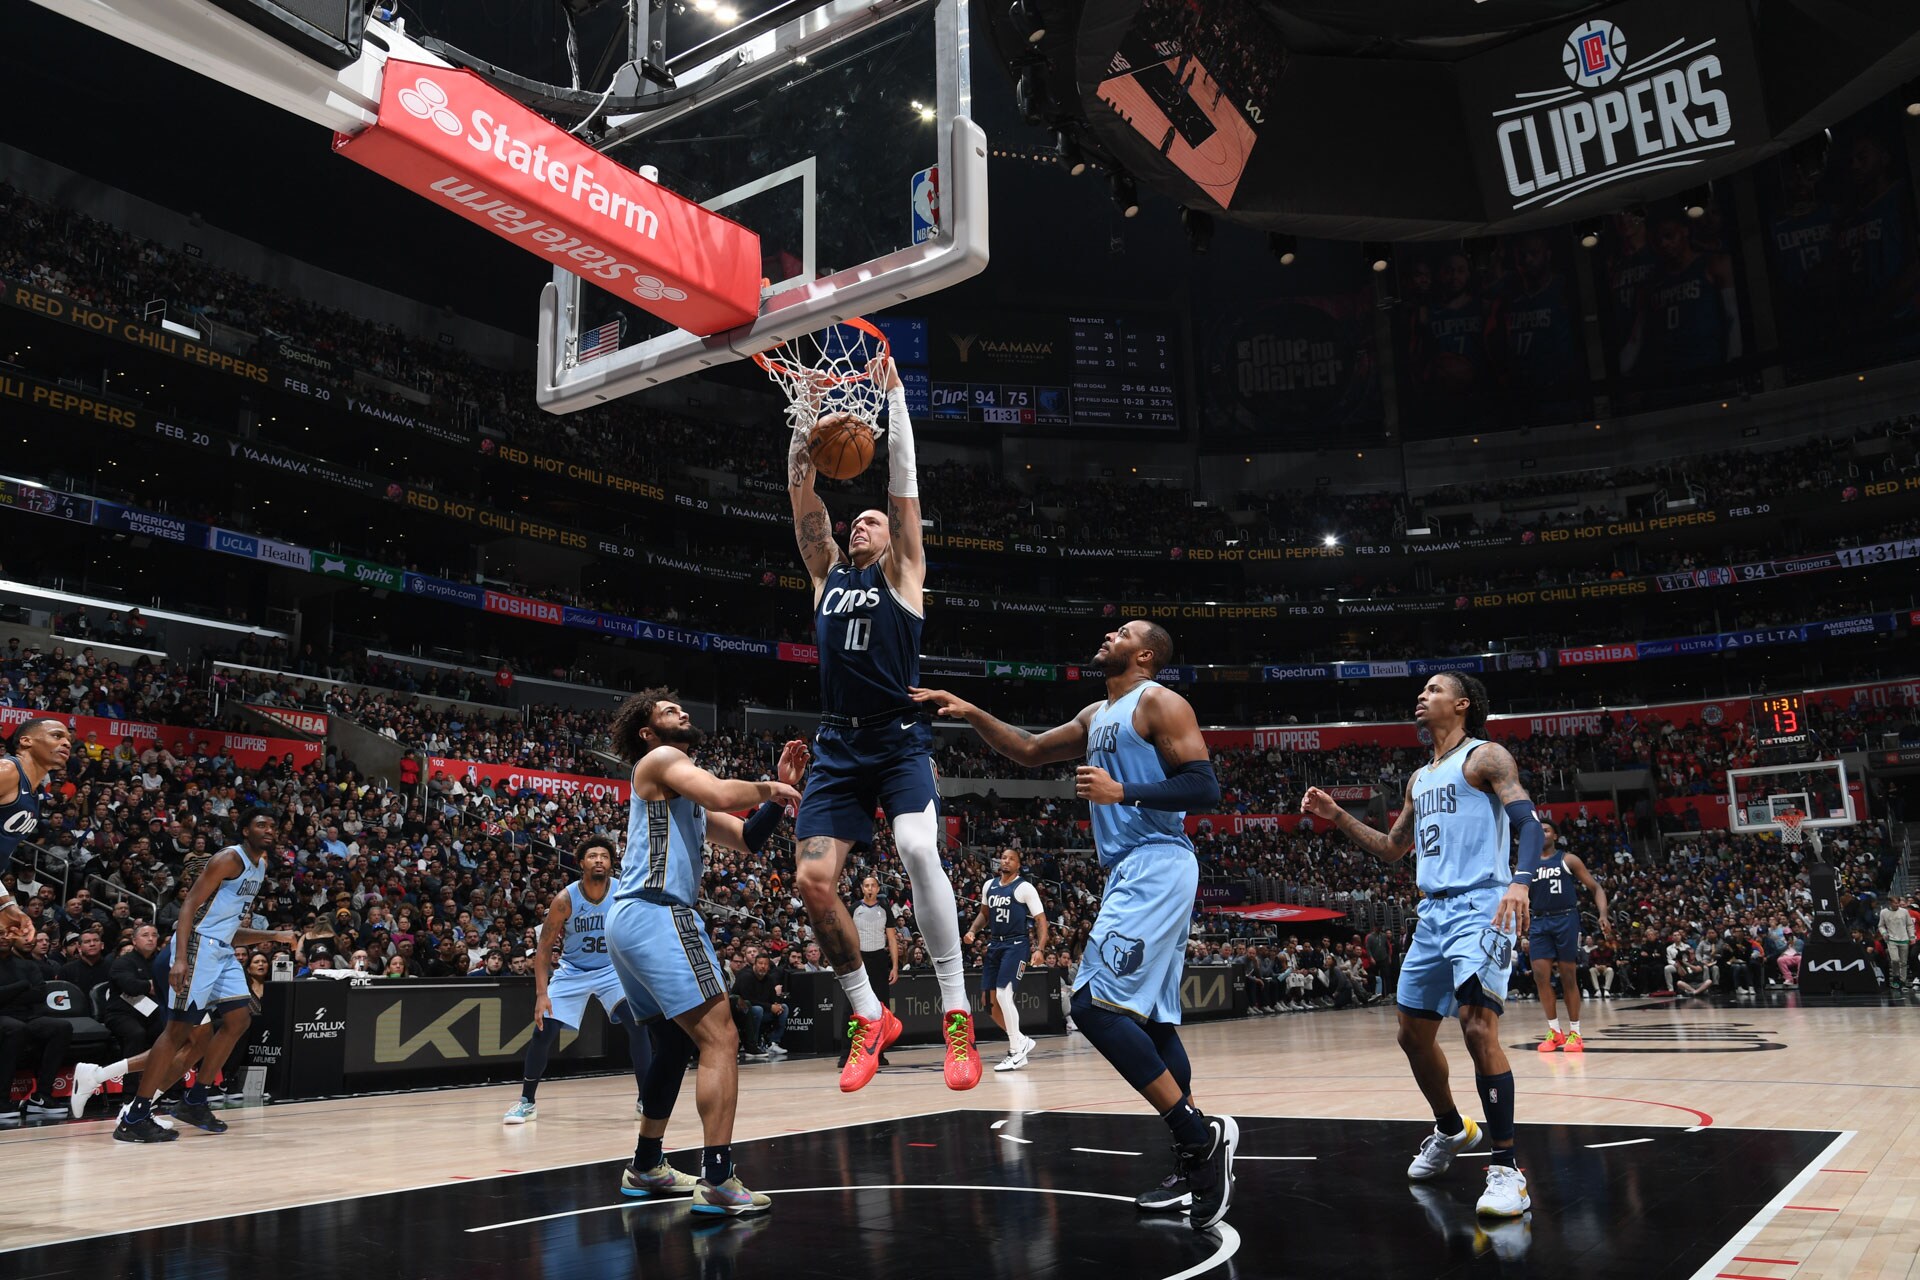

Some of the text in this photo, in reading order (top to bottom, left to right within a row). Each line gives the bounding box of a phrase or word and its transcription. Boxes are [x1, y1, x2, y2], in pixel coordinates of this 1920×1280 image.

[1497, 54, 1731, 197] CLIPPERS
[16, 288, 64, 316] RED
[71, 306, 118, 334] HOT
[123, 324, 176, 354] CHILI
[183, 343, 269, 383] PEPPERS
[284, 377, 311, 396] FEB.
[315, 387, 330, 401] 20
[280, 344, 331, 371] Spectrum
[975, 390, 995, 404] 94
[1008, 391, 1027, 406] 75
[33, 385, 136, 430] PEPPERS
[155, 422, 187, 441] FEB.
[192, 432, 209, 447] 20
[984, 410, 1019, 421] 11:31
[499, 446, 528, 464] RED
[533, 455, 565, 473] HOT
[568, 465, 603, 484] CHILI
[607, 474, 665, 500] PEPPERS
[675, 494, 694, 507] FEB.
[697, 499, 709, 510] 20
[1864, 480, 1900, 497] RED
[121, 510, 186, 532] AMERICAN
[1540, 503, 1771, 543] RED HOT CHILI PEPPERS FEB. 20
[129, 522, 186, 541] EXPRESS
[407, 490, 439, 511] RED
[443, 501, 475, 521] HOT
[479, 511, 515, 532] CHILI
[599, 541, 621, 555] FEB.
[623, 546, 635, 558] 20
[779, 575, 806, 590] RED
[922, 534, 1047, 554] HILI PEPPERS FEB. 20
[222, 536, 305, 566] UCLA Health
[1188, 549, 1214, 560] RED
[1218, 549, 1244, 560] HOT
[1248, 549, 1281, 560] CHILI
[1285, 546, 1345, 559] PEPPERS
[1355, 545, 1377, 555] FEB.
[1379, 545, 1391, 554] 20
[1843, 544, 1897, 566] 11:31
[1743, 565, 1766, 580] 94
[1785, 557, 1831, 573] Clippers
[353, 564, 394, 584] Sprite
[427, 583, 477, 601] crypto.com
[1473, 581, 1647, 608] RED HOT CHILI PEPPERS
[489, 594, 559, 621] TOSHIBA
[945, 597, 965, 607] FEB.
[967, 598, 980, 608] 20
[1120, 605, 1147, 617] RED
[1152, 606, 1179, 617] HOT
[1182, 606, 1215, 618] CHILI
[1219, 606, 1278, 618] PEPPERS
[1289, 606, 1310, 615] FEB.
[1312, 605, 1324, 614] 20
[603, 619, 633, 633] ULTRA
[1822, 618, 1873, 631] AMERICAN
[1830, 625, 1876, 636] EXPRESS
[657, 628, 701, 646] DELTA
[844, 618, 872, 651] 10
[1743, 630, 1798, 644] DELTA
[712, 636, 768, 654] Spectrum
[1681, 640, 1714, 651] ULTRA
[1562, 648, 1634, 663] TOSHIBA
[1018, 664, 1048, 678] Sprite
[1272, 667, 1327, 680] Spectrum
[1344, 664, 1405, 676] UCLA Health
[1429, 661, 1475, 671] crypto.com
[1763, 698, 1799, 712] 11:31
[1546, 715, 1602, 737] CLIPPERS
[1773, 711, 1799, 733] 13
[120, 722, 158, 739] CLIPPERS
[234, 735, 267, 752] CLIPPERS
[304, 744, 318, 752] 101
[1267, 731, 1320, 751] CLIPPERS
[432, 759, 444, 767] 102
[508, 774, 619, 801] CLIPPERS.COM
[1420, 824, 1440, 857] 12
[1202, 889, 1230, 897] ULTRA
[1550, 879, 1562, 894] 21
[988, 895, 1011, 908] Clips
[996, 908, 1010, 923] 24
[350, 978, 372, 986] anc
[46, 990, 72, 1010] G
[905, 997, 929, 1015] The
[294, 1020, 346, 1034] STARLUX
[302, 1030, 338, 1039] AIRLINES
[249, 1044, 282, 1057] STARLUX
[253, 1056, 277, 1064] AIRLINES
